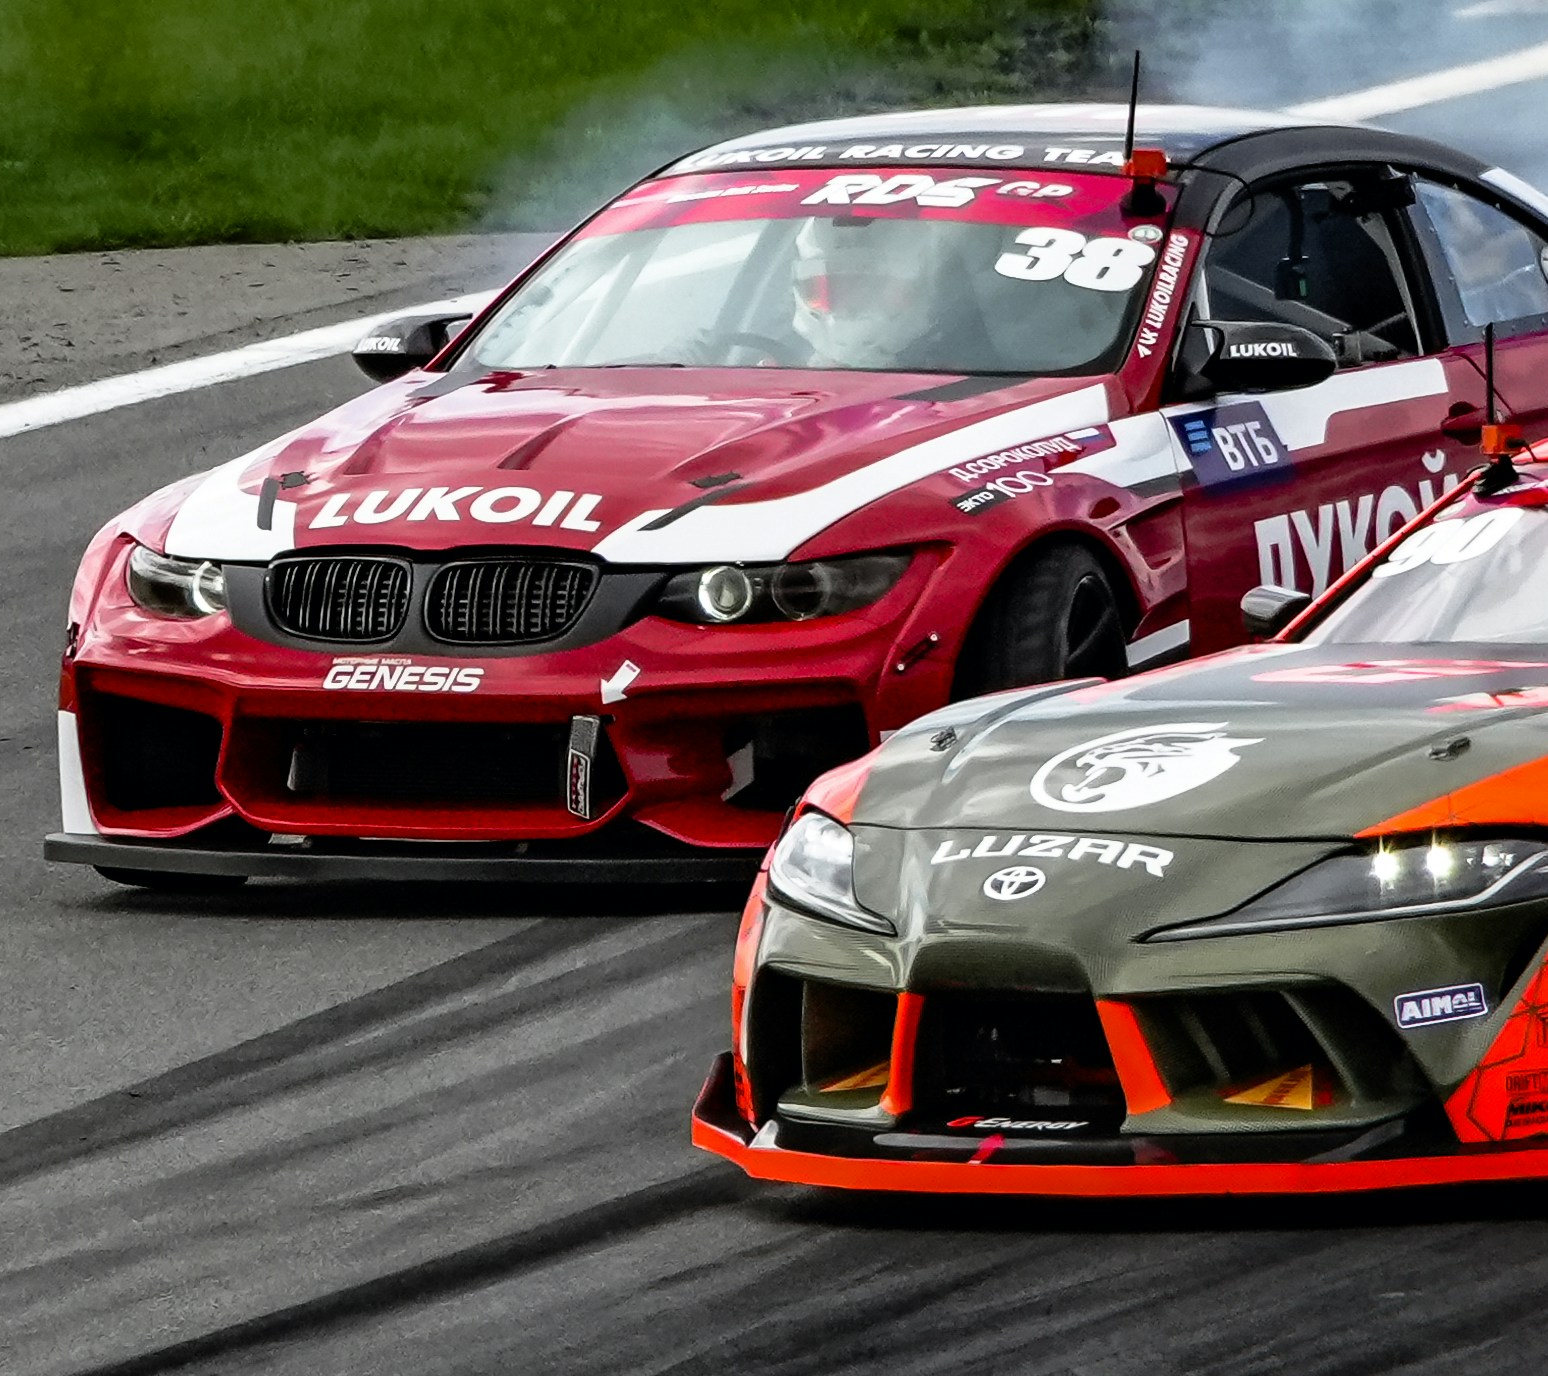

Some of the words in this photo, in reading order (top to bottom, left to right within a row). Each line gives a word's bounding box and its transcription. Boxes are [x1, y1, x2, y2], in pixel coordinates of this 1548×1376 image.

[839, 144, 1025, 162] RACING
[1044, 147, 1126, 166] TEA
[801, 174, 1003, 207] RDS
[997, 180, 1074, 199] GP
[995, 228, 1157, 291] 38
[1229, 342, 1297, 359] LUKOIL
[1211, 420, 1280, 472] ВТБ
[985, 470, 1053, 498] 100
[308, 486, 603, 532] LUKOIL
[1372, 507, 1525, 579] 90
[323, 665, 485, 693] GENESIS
[931, 834, 1175, 878] LUZAR
[1401, 991, 1483, 1022] AIMOL
